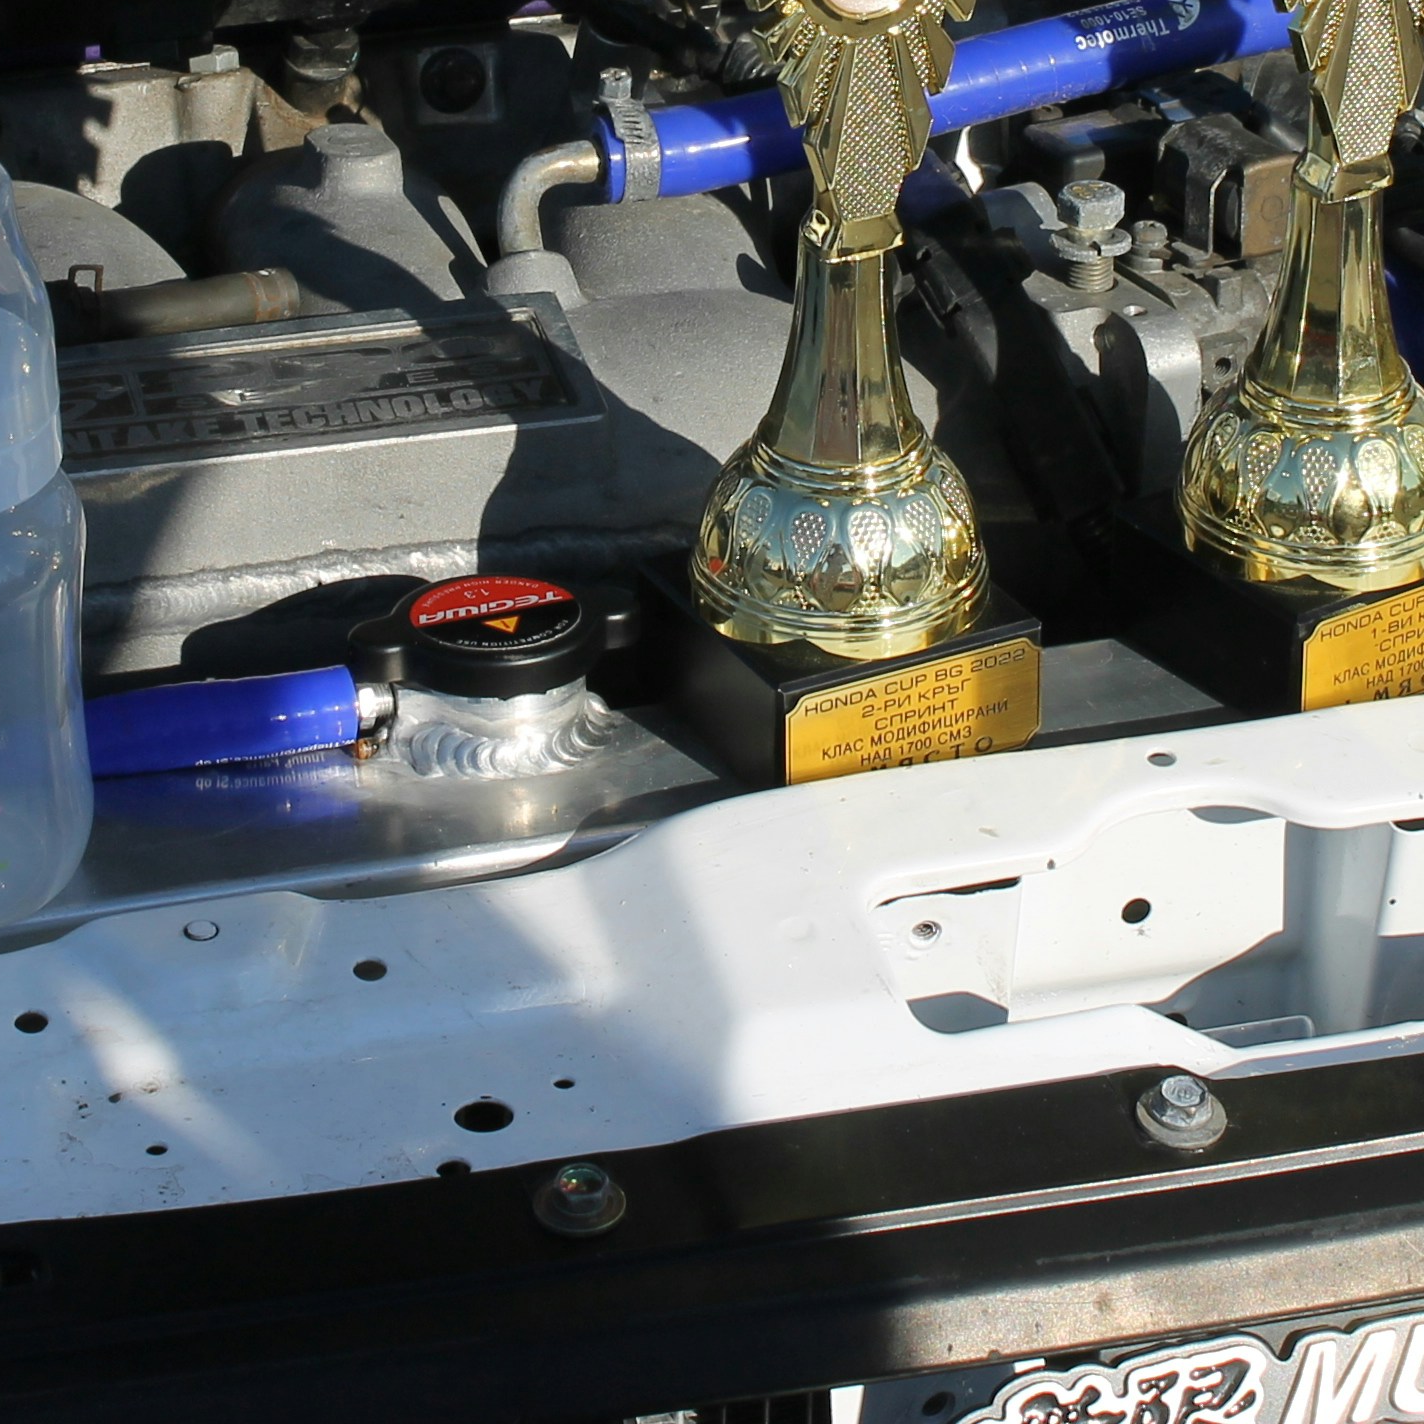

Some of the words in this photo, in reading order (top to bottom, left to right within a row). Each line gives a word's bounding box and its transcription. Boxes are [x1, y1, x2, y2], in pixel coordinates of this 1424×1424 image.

[1075, 17, 1171, 52] Thermotec
[61, 417, 224, 455] NTAKE
[242, 378, 547, 437] TECHNOLOGY
[419, 591, 564, 625] TEGIWA
[1320, 611, 1383, 643] HONDA
[1371, 614, 1413, 639] 1-ВИ
[804, 688, 877, 717] HONDA
[884, 674, 927, 696] CUP
[934, 664, 963, 682] BG
[970, 648, 1026, 673] 2022
[1333, 663, 1370, 686] КЛАС
[1366, 669, 1394, 689] НАД
[861, 695, 912, 719] 2-РИ
[917, 678, 972, 703] КРЪГ
[874, 698, 959, 731] СПРИНТ
[822, 738, 863, 761] КЛАС
[870, 700, 1008, 747] МОДИФИЦИРАНИ
[860, 748, 892, 767] НАД
[898, 737, 932, 756] 1700
[871, 736, 993, 771] ЯСТО
